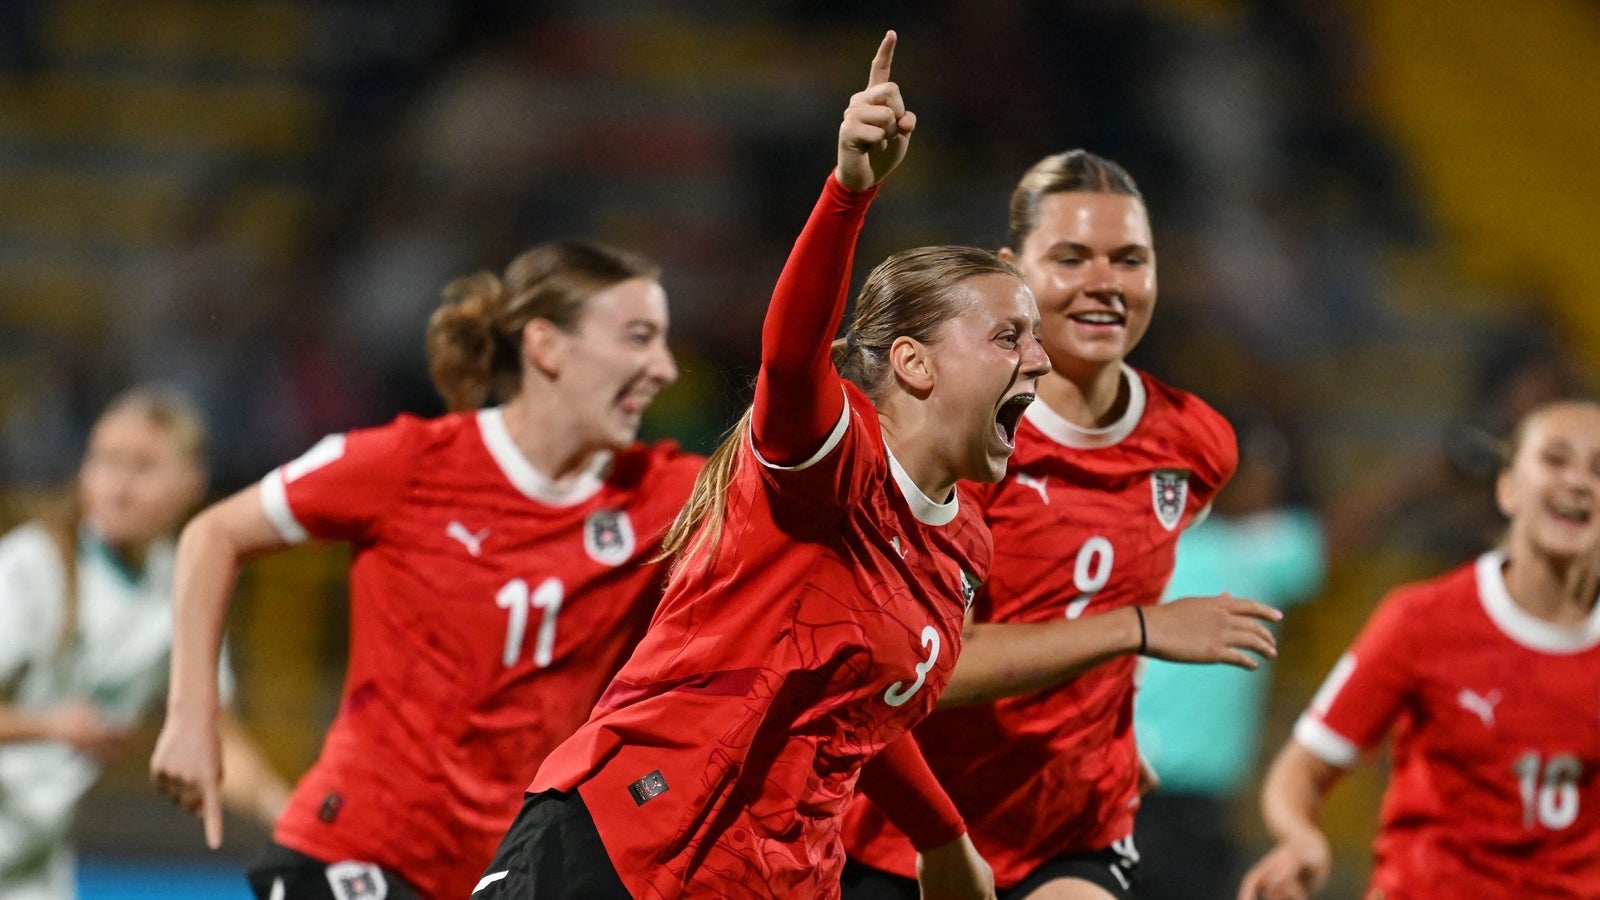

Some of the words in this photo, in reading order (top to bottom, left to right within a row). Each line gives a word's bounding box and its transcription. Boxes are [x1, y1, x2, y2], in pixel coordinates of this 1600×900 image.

[1065, 535, 1114, 620] 9
[494, 577, 565, 668] 11
[884, 625, 940, 707] 3
